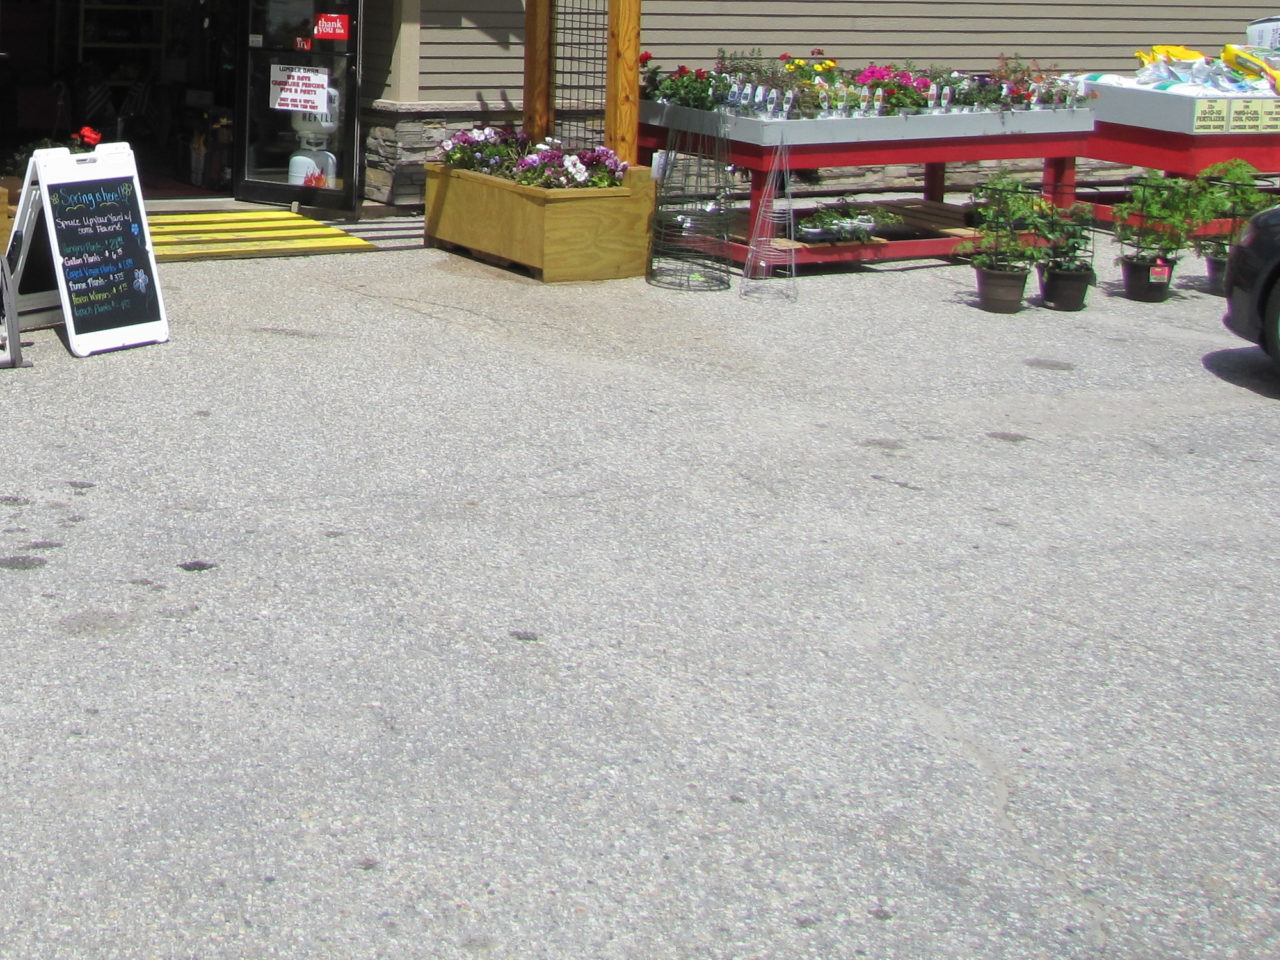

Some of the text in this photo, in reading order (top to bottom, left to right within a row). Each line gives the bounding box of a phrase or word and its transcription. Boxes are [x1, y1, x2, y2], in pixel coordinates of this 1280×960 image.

[318, 17, 342, 29] thank
[318, 27, 334, 35] you
[302, 112, 334, 123] REFILL
[60, 188, 96, 210] Spring
[56, 217, 81, 229] Spruce
[64, 256, 83, 267] Gallon
